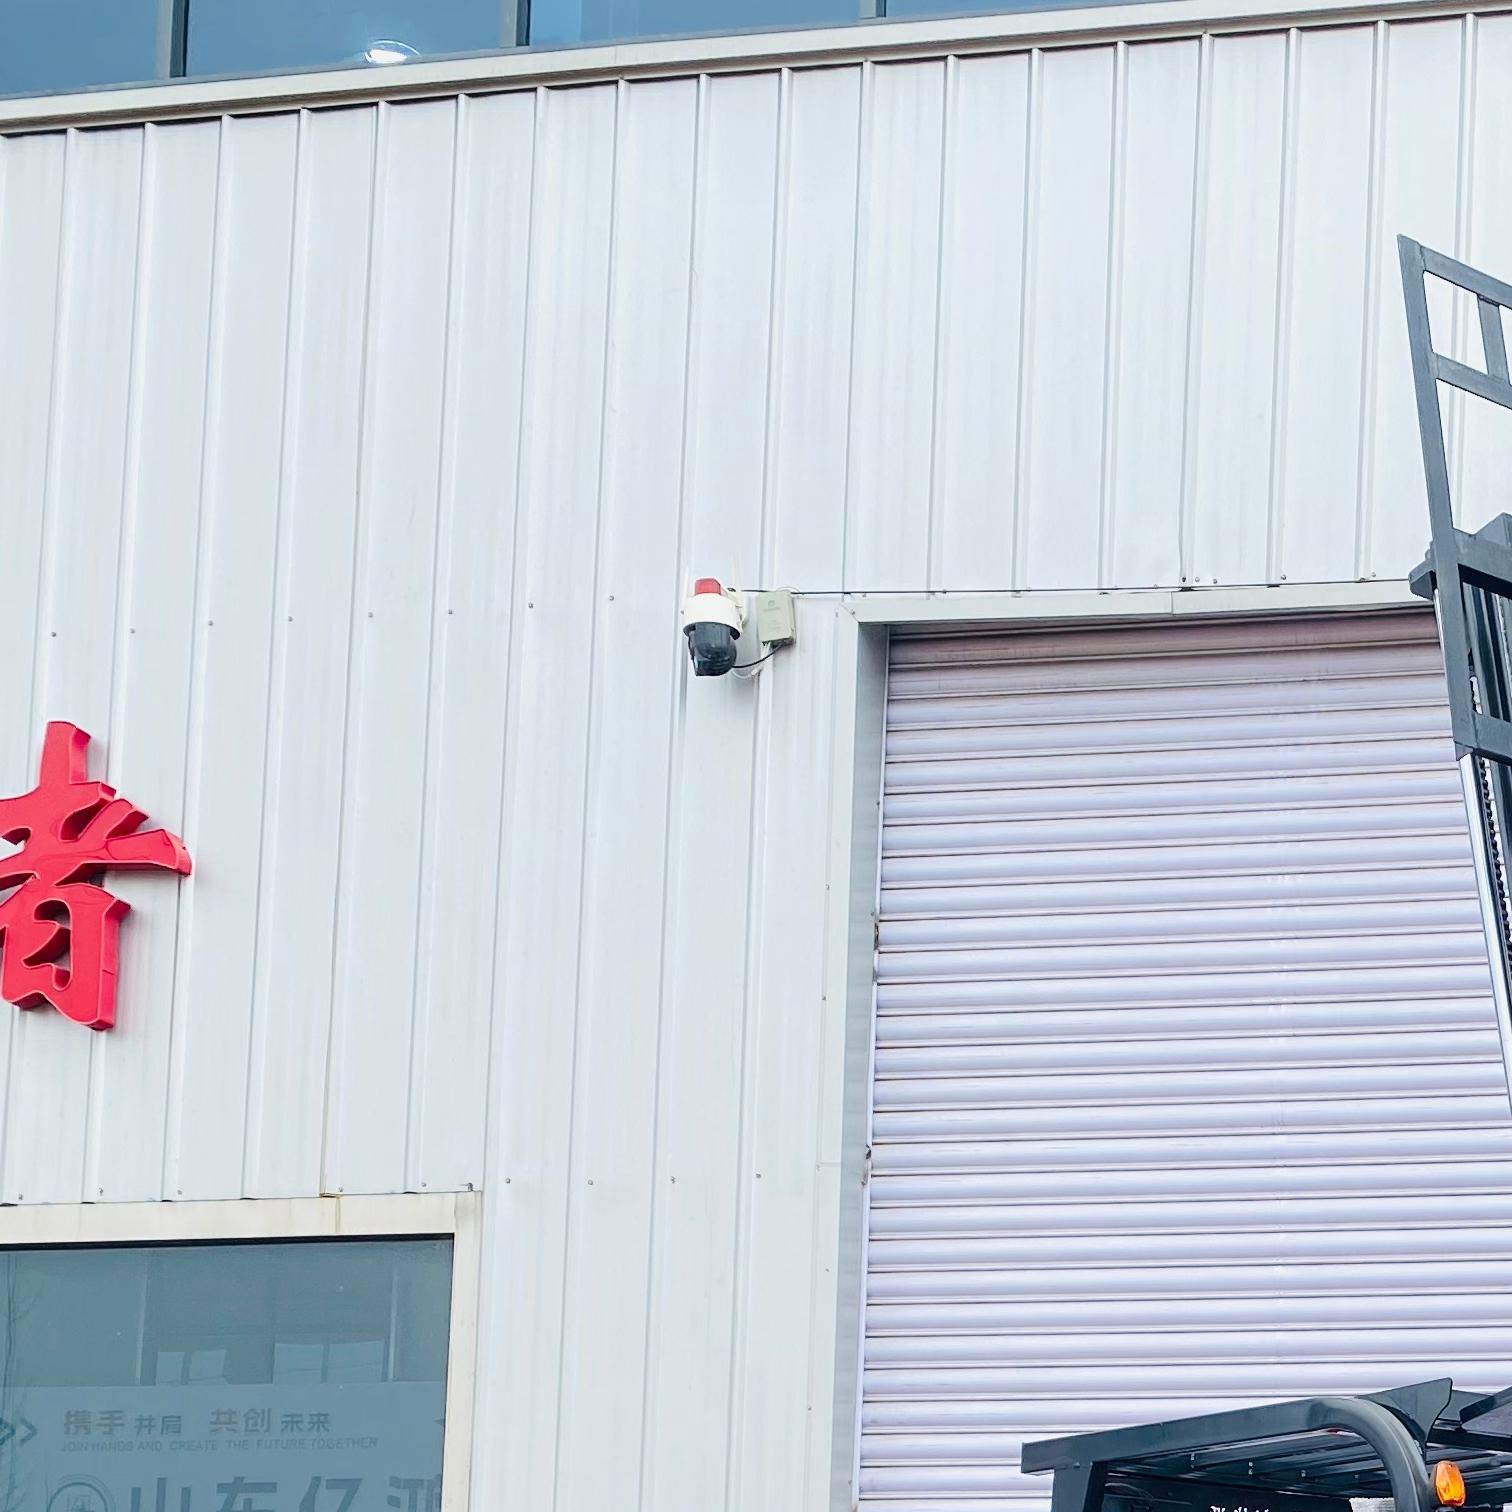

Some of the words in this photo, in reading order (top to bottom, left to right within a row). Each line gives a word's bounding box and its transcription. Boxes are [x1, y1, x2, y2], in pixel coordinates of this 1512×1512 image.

[209, 1407, 331, 1433] 共创未来
[137, 1440, 163, 1451] AND
[169, 1439, 217, 1451] CREATE
[226, 1438, 249, 1450] THE
[256, 1438, 306, 1450] FUTURE
[310, 1436, 379, 1450] TOGETHER
